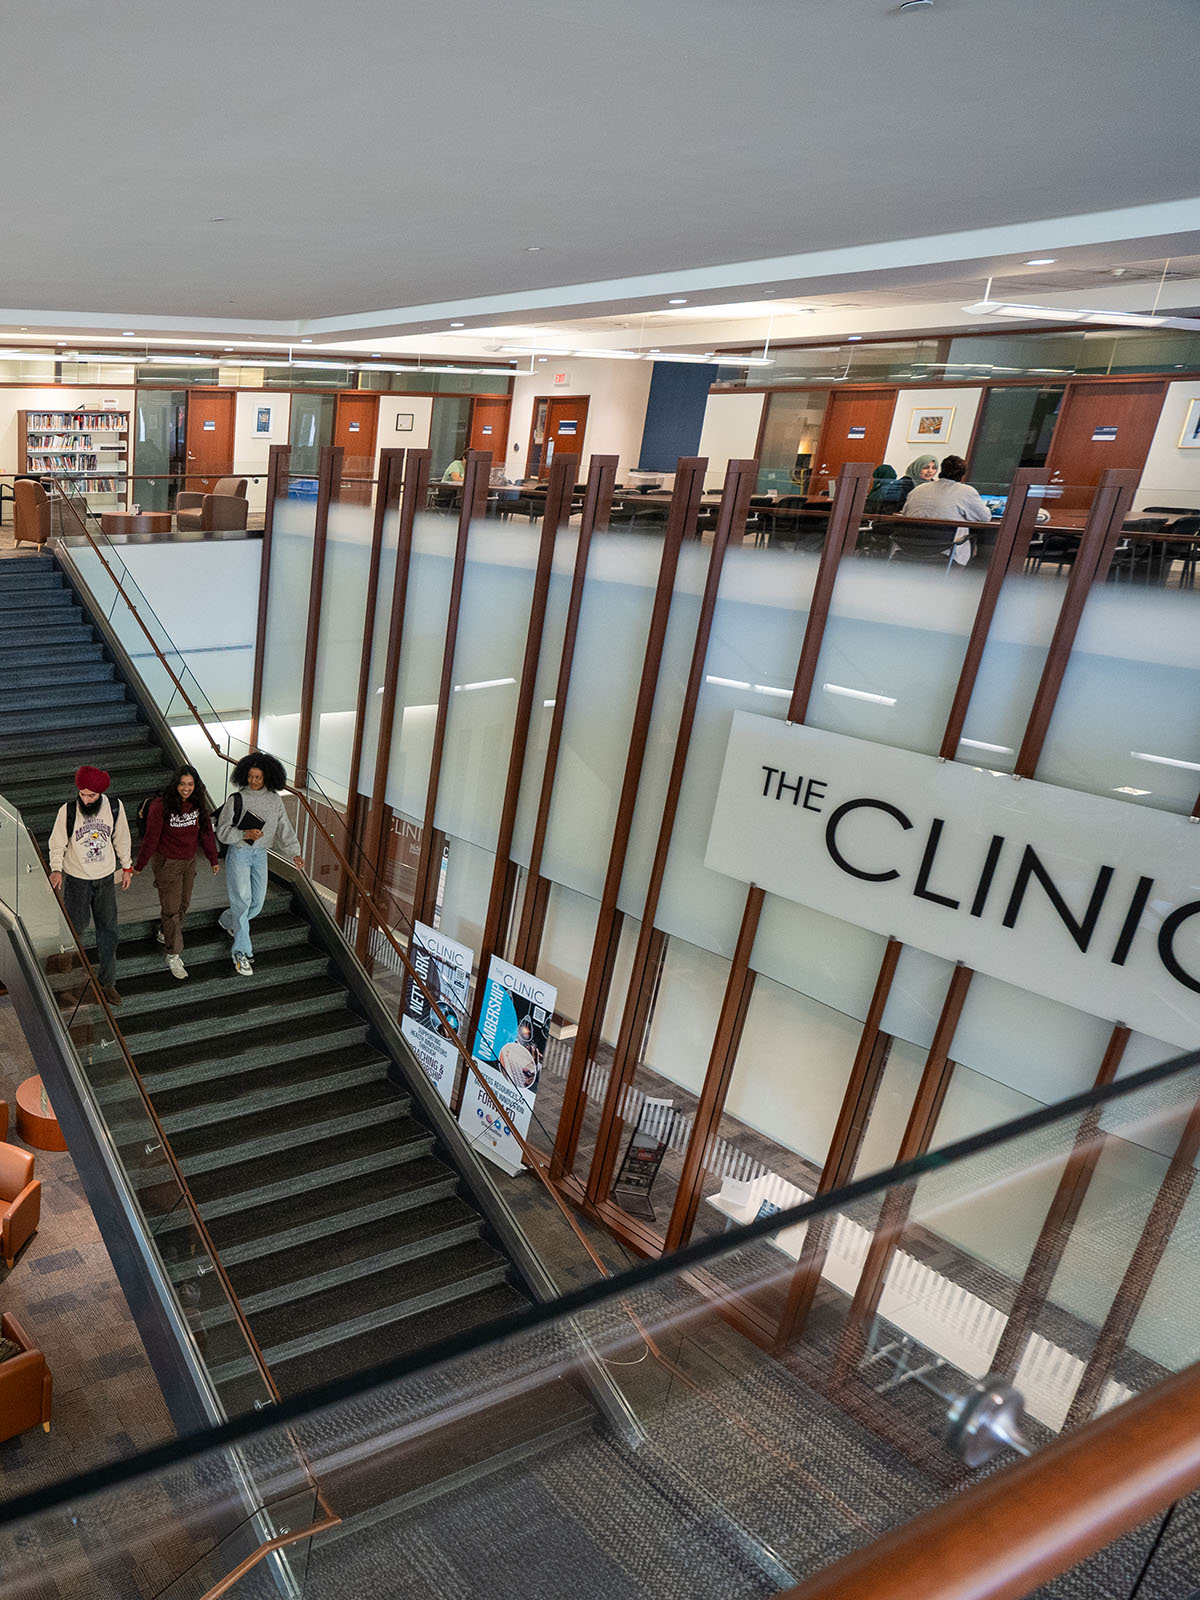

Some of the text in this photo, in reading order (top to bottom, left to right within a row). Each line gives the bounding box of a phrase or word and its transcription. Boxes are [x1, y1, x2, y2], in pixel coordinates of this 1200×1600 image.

[555, 374, 566, 383] EXIT
[761, 765, 828, 813] THE
[390, 817, 422, 842] LINI
[825, 798, 1200, 994] CLINIC
[427, 938, 464, 967] CLINIC
[503, 974, 544, 1005] CLINIC
[478, 982, 505, 1060] MEMBERSHIP
[439, 1064, 444, 1075] &
[477, 1090, 516, 1123] FORD
